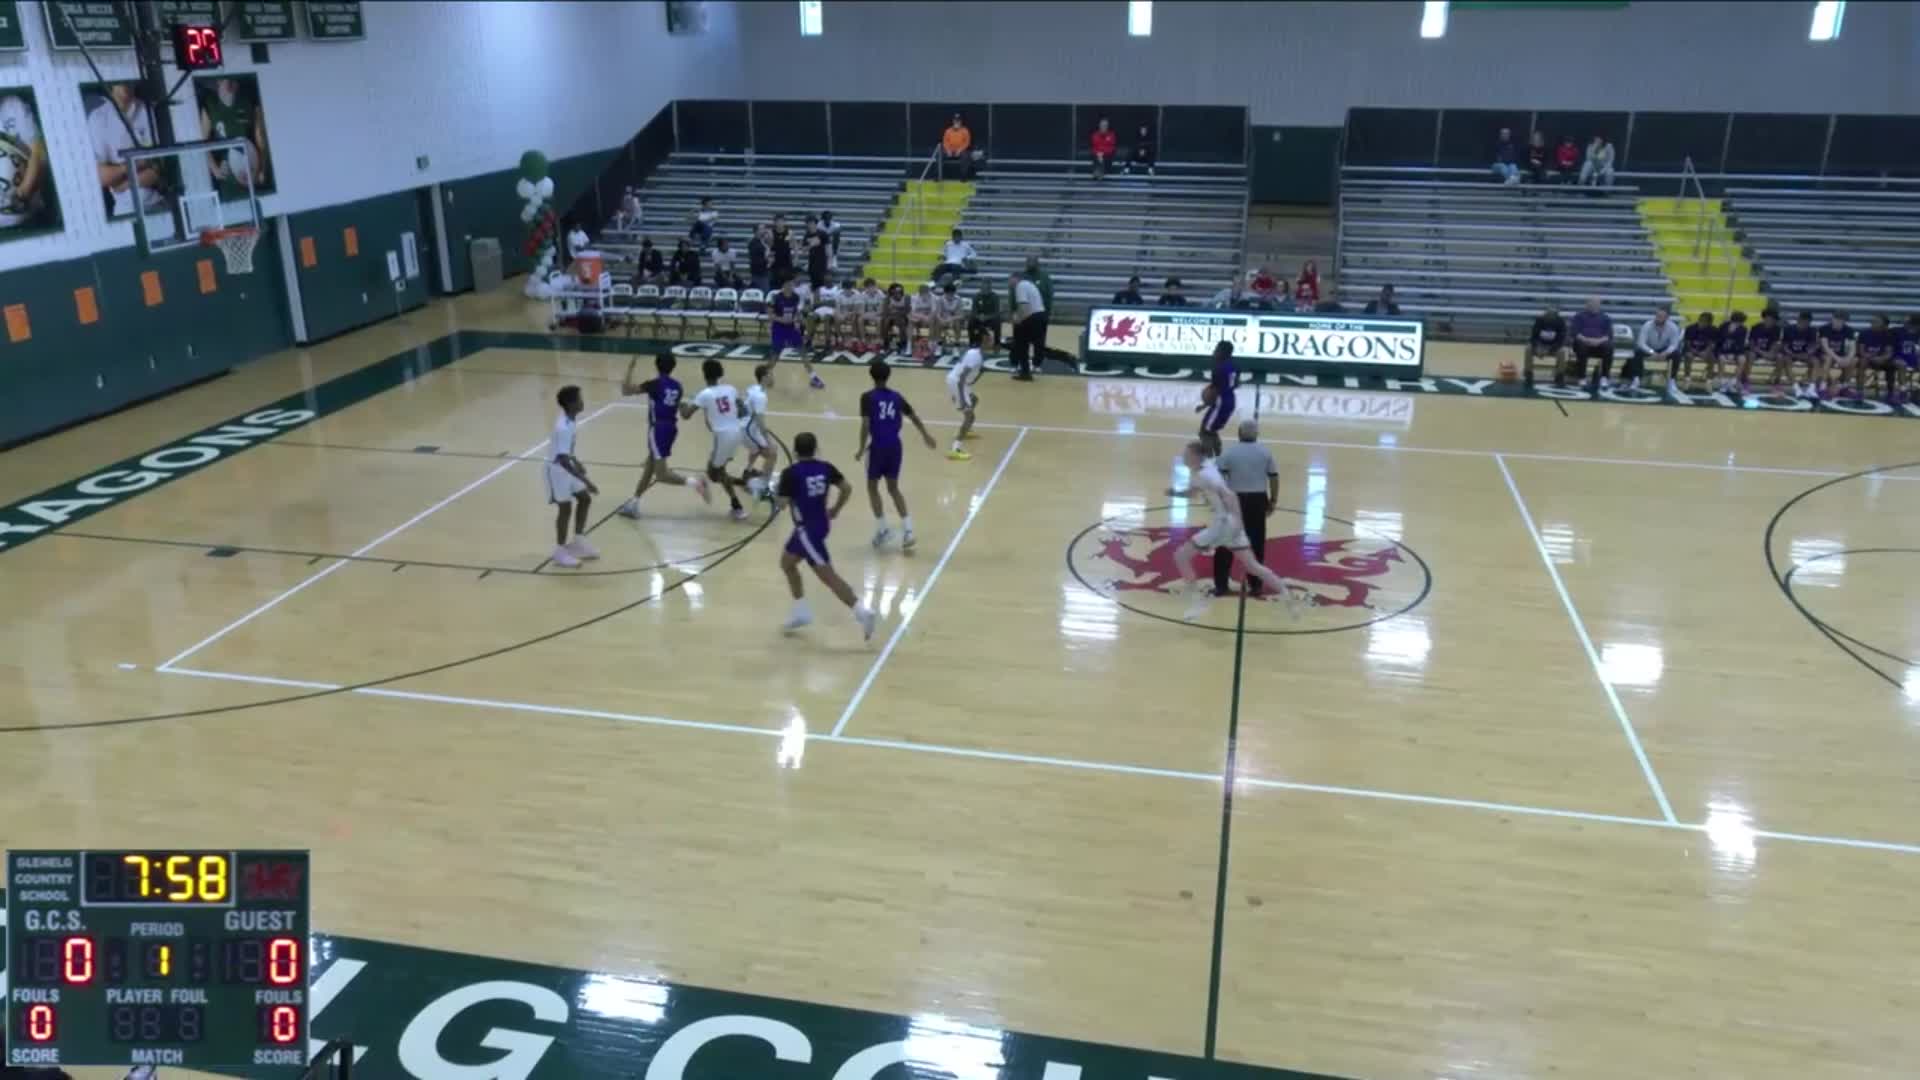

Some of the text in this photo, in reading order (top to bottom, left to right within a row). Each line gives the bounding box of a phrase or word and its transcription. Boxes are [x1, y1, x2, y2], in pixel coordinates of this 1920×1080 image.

[1147, 325, 1248, 343] GLENELG
[1257, 331, 1416, 360] DRAGONS
[715, 396, 731, 414] 15
[877, 400, 896, 420] 34
[805, 475, 827, 497] 55
